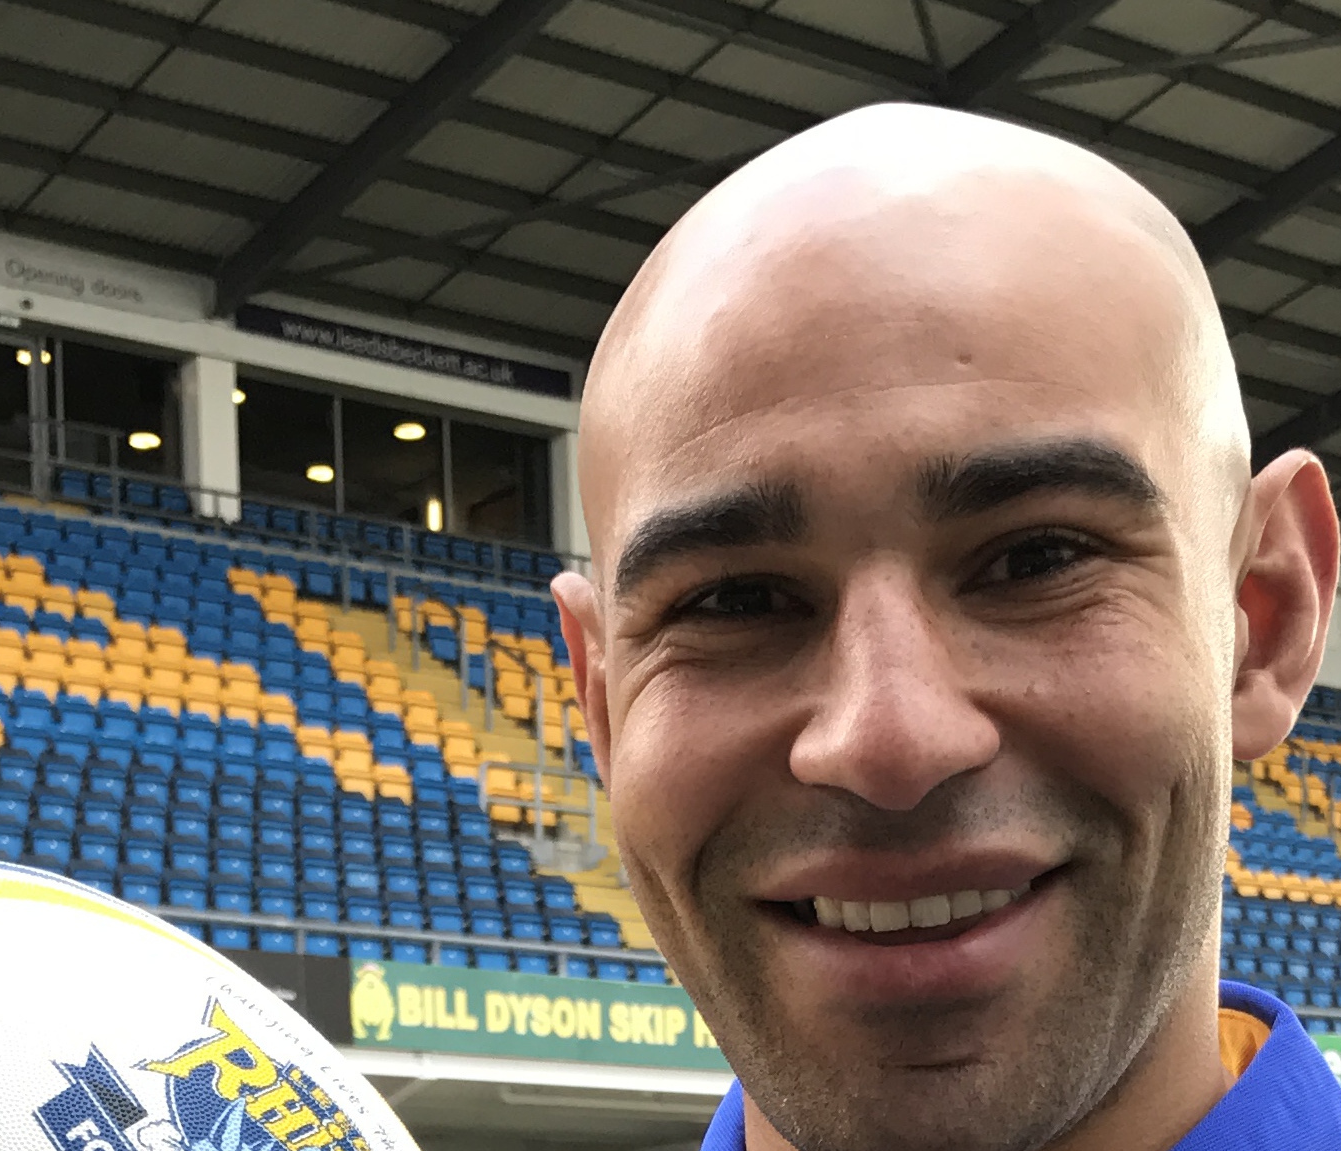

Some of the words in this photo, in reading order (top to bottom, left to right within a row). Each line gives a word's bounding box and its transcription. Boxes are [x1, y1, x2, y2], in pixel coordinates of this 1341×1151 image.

[397, 983, 478, 1031] BILL
[485, 990, 602, 1041] DYSON
[608, 1001, 687, 1047] SKIP
